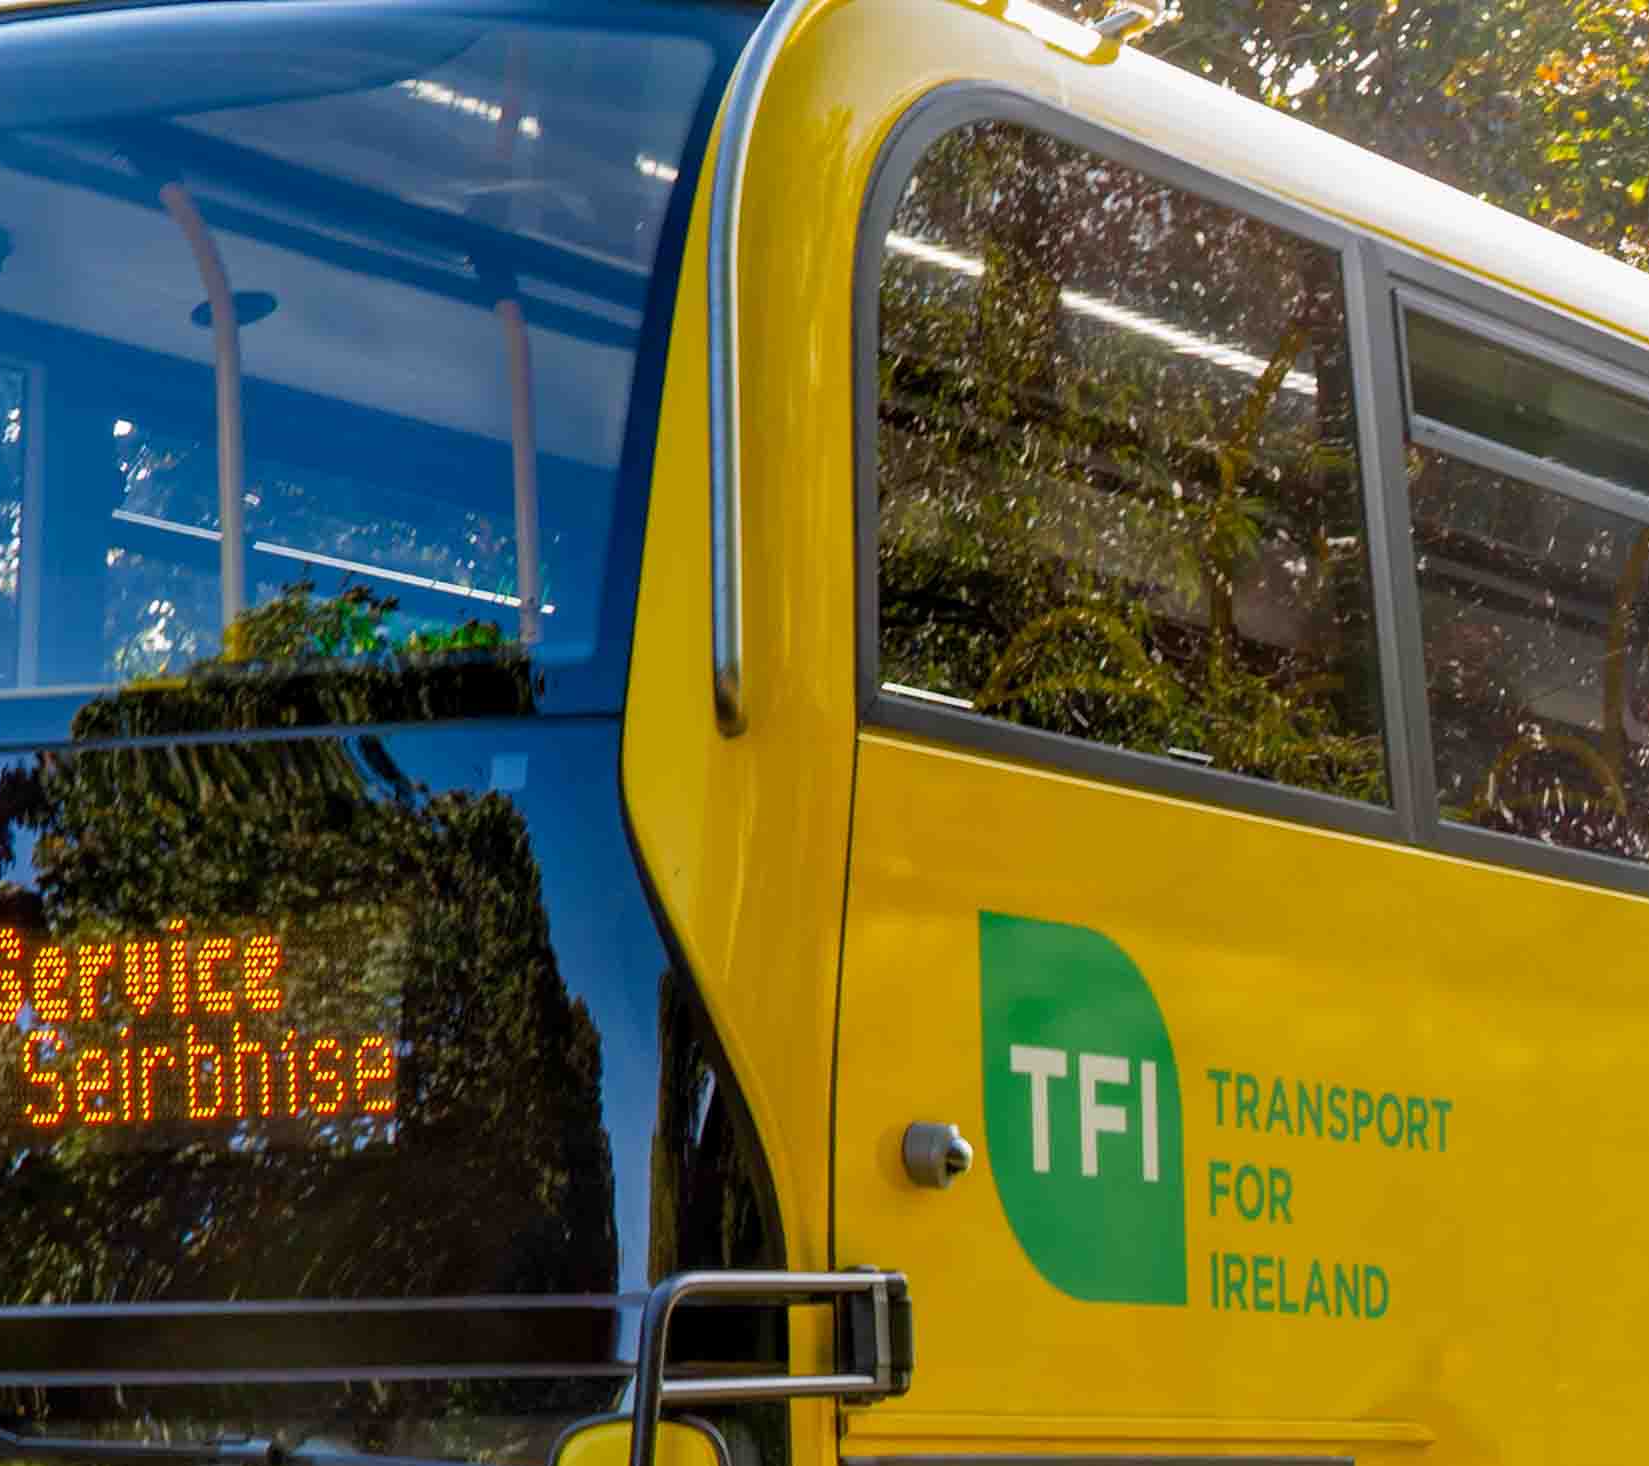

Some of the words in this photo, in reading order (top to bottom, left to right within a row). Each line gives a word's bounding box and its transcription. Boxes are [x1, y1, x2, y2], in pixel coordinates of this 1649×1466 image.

[1010, 1044, 1160, 1181] TFI
[1207, 1069, 1452, 1153] TRANSPORT
[1209, 1161, 1293, 1224] FOR
[1210, 1252, 1390, 1319] IRELAND
